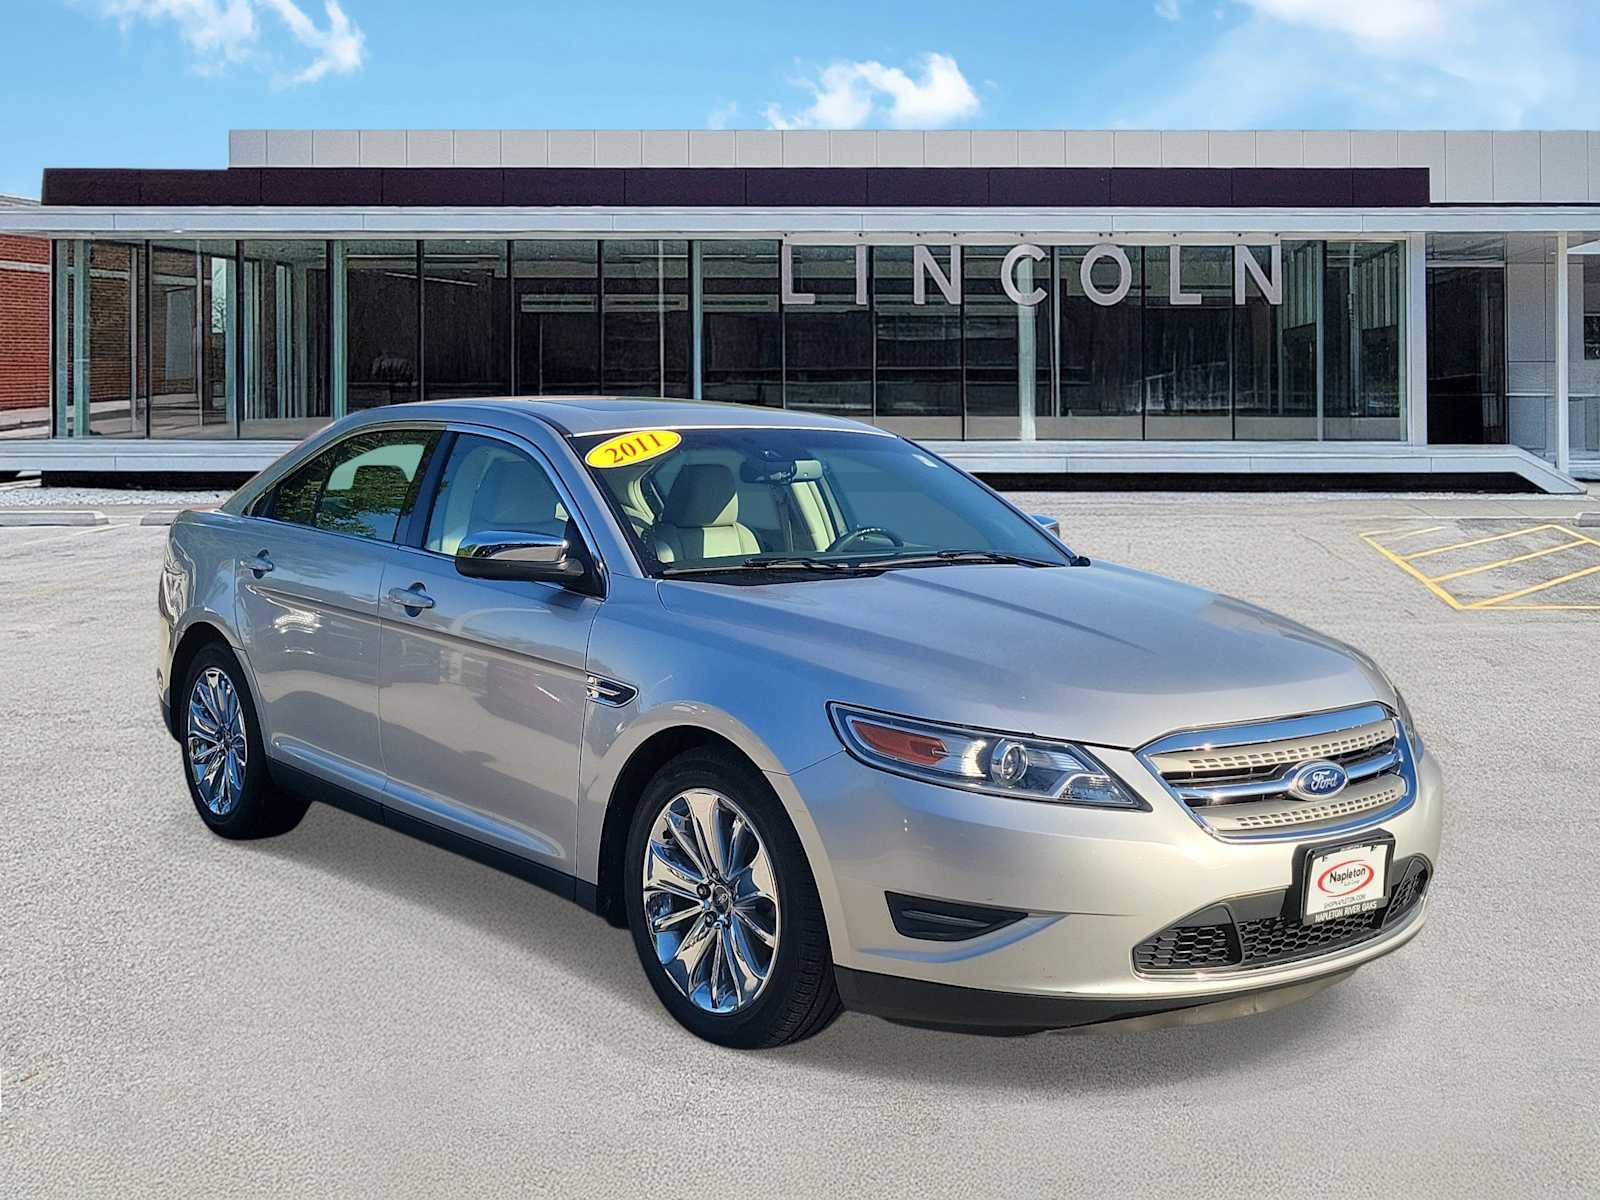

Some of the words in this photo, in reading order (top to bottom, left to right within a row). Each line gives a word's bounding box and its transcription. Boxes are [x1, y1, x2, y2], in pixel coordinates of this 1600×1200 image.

[781, 244, 1282, 306] LINCOLN
[604, 433, 662, 464] 2011
[1310, 769, 1338, 791] Ford
[1329, 867, 1366, 884] Napleton
[1343, 904, 1361, 916] RIVER
